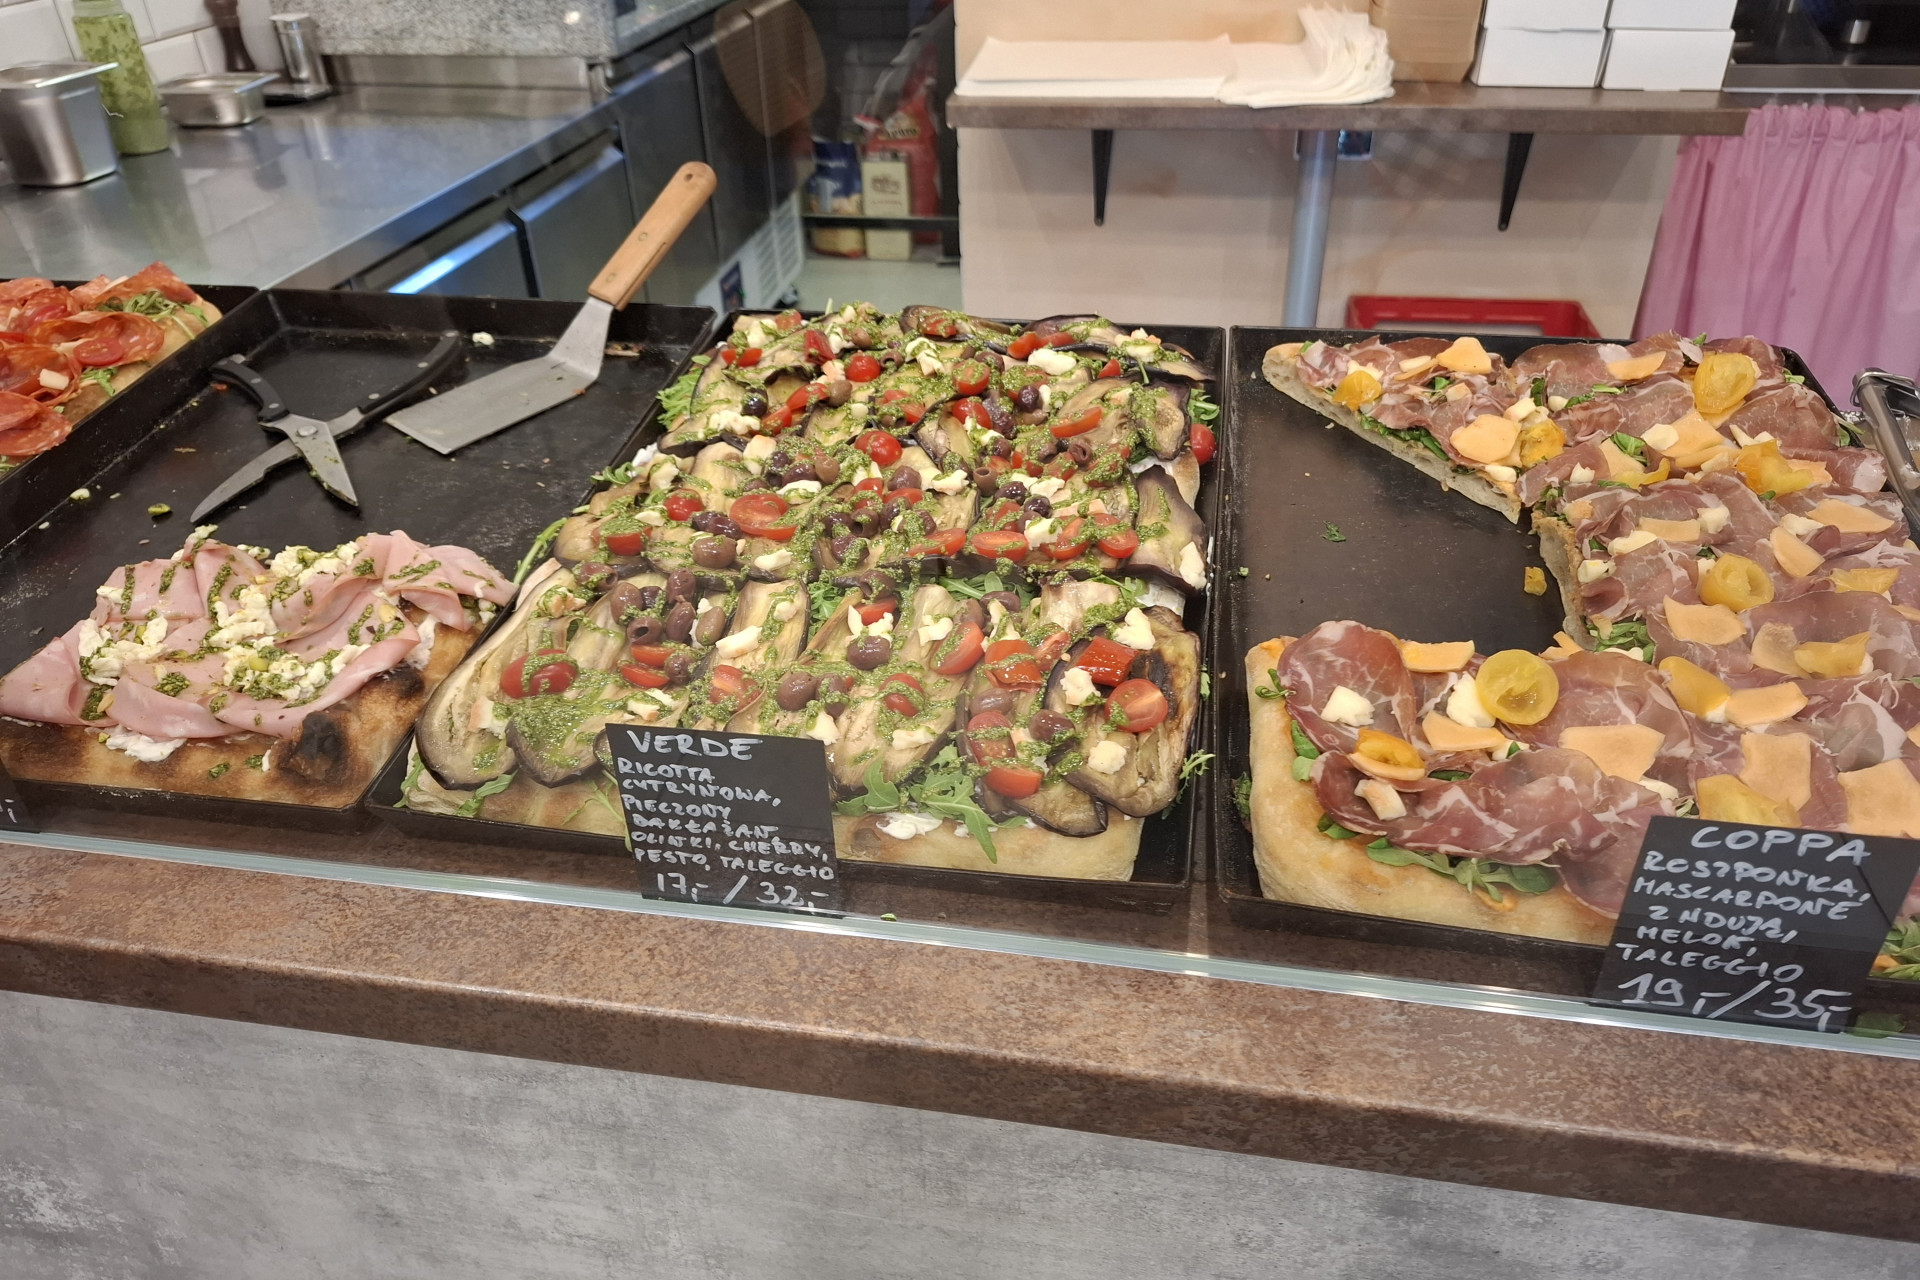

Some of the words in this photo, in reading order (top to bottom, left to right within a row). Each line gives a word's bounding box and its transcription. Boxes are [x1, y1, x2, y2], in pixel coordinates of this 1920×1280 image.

[626, 730, 763, 761] VERDE
[617, 757, 716, 784] RICOTTA
[621, 793, 731, 819] PIECZONY
[622, 778, 782, 807] CYTRYNOWA,
[1691, 826, 1871, 866] COPPA
[719, 855, 835, 880] TALEGGIO
[1633, 876, 1863, 920] MASCARPONE
[1615, 943, 1804, 983] TALEGGIO
